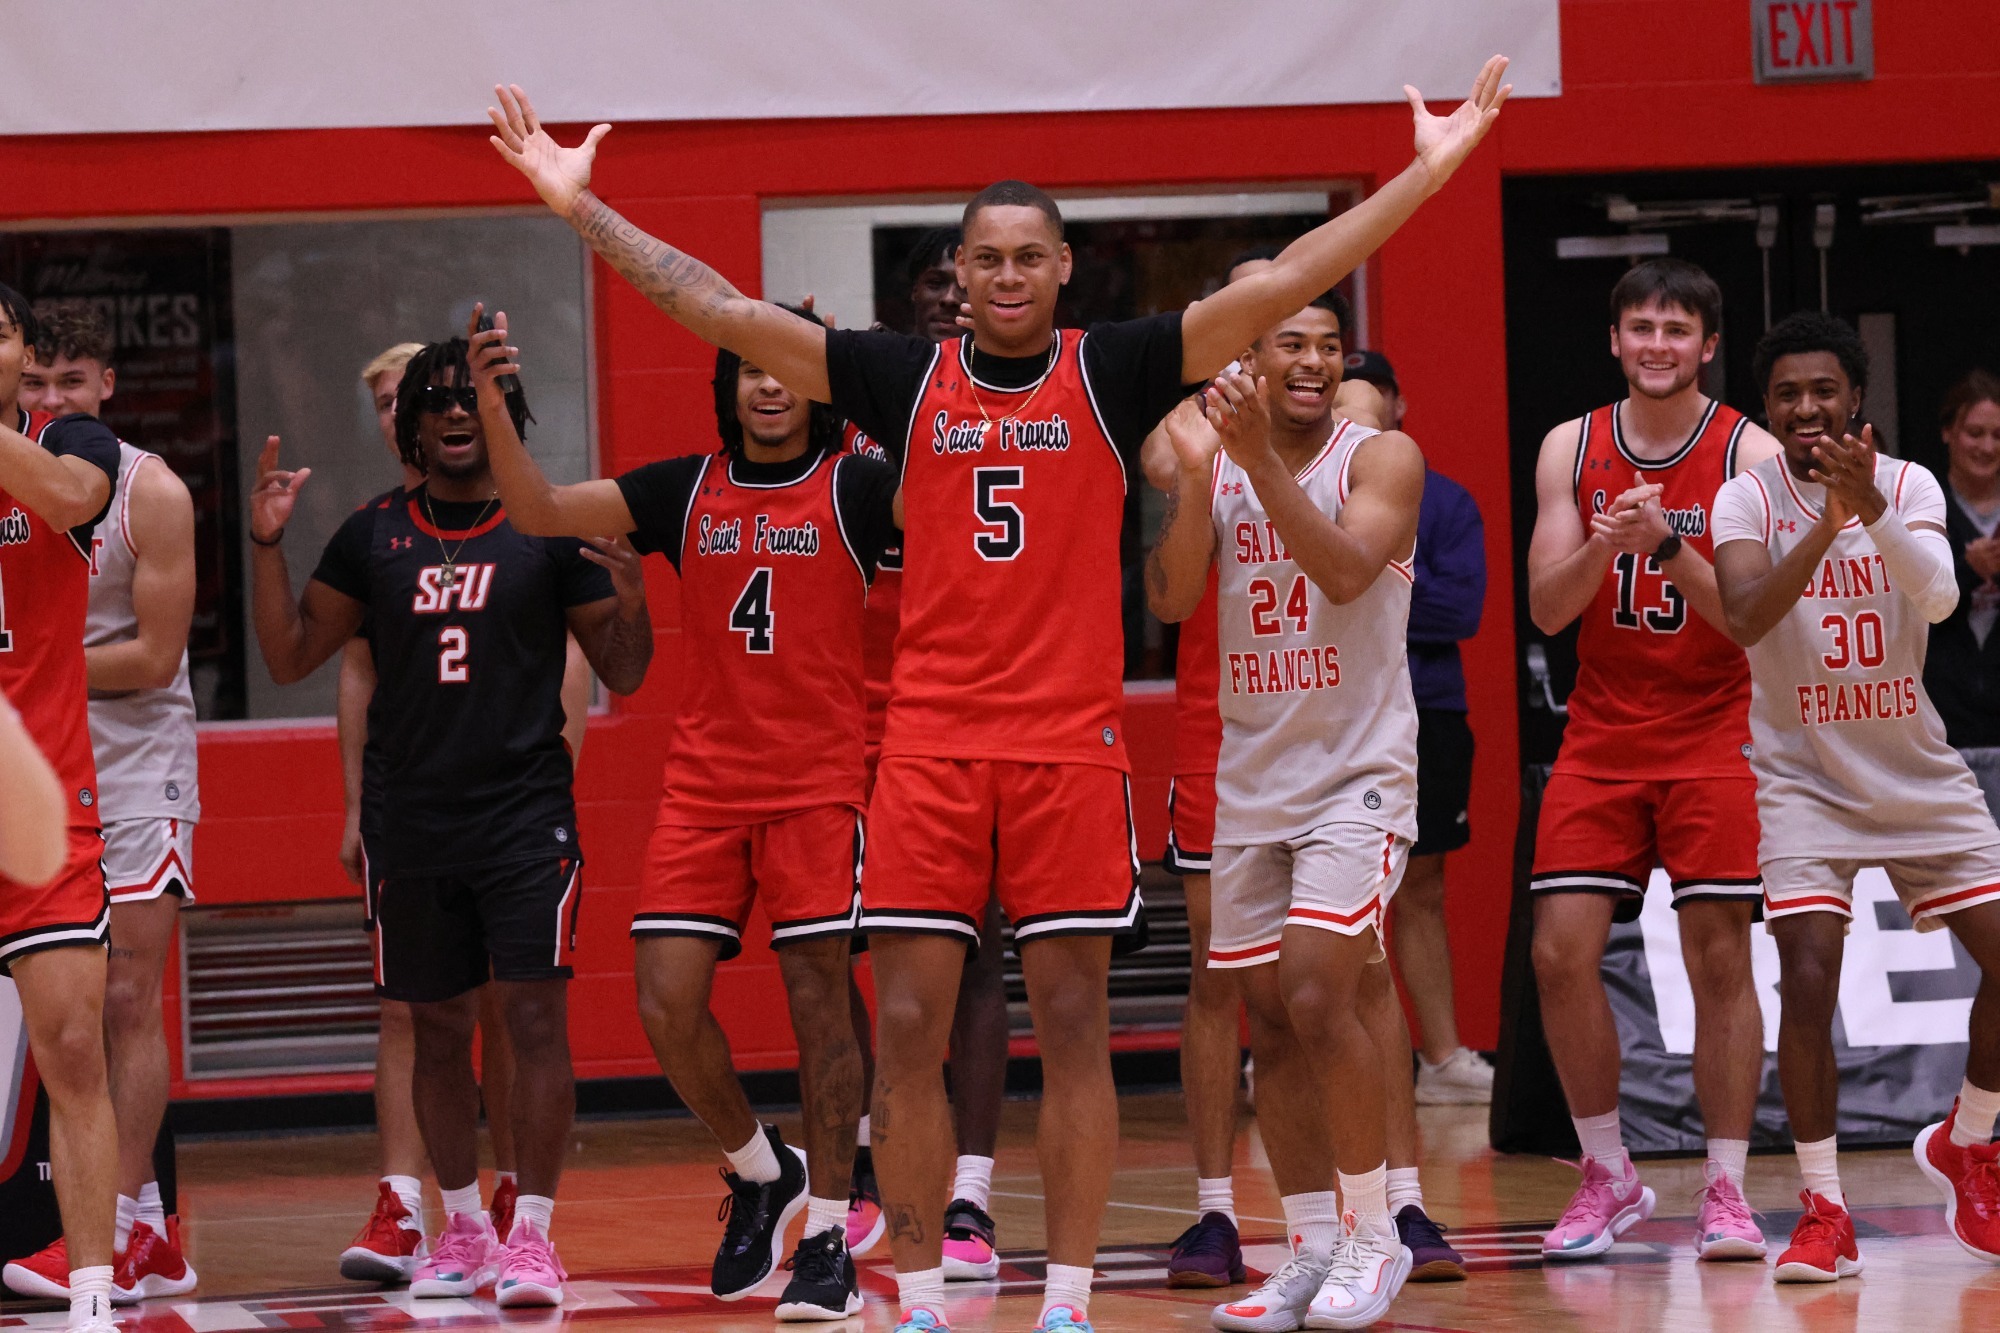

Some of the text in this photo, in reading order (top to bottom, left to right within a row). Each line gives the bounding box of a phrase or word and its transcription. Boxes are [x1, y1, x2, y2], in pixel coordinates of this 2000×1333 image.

[1768, 1, 1860, 68] EXIT
[933, 409, 1070, 455] Saint Francis
[698, 513, 819, 556] Saint Francis
[973, 466, 1025, 561] 5
[1235, 519, 1295, 565] SAI
[412, 563, 497, 615] SFU
[729, 567, 775, 654] 4
[1247, 573, 1311, 638] 24
[1613, 552, 1687, 634] 13
[438, 625, 471, 684] 2
[1227, 644, 1342, 695] FRANCIS
[1820, 609, 1887, 672] 30
[1796, 675, 1918, 726] FRANCIS
